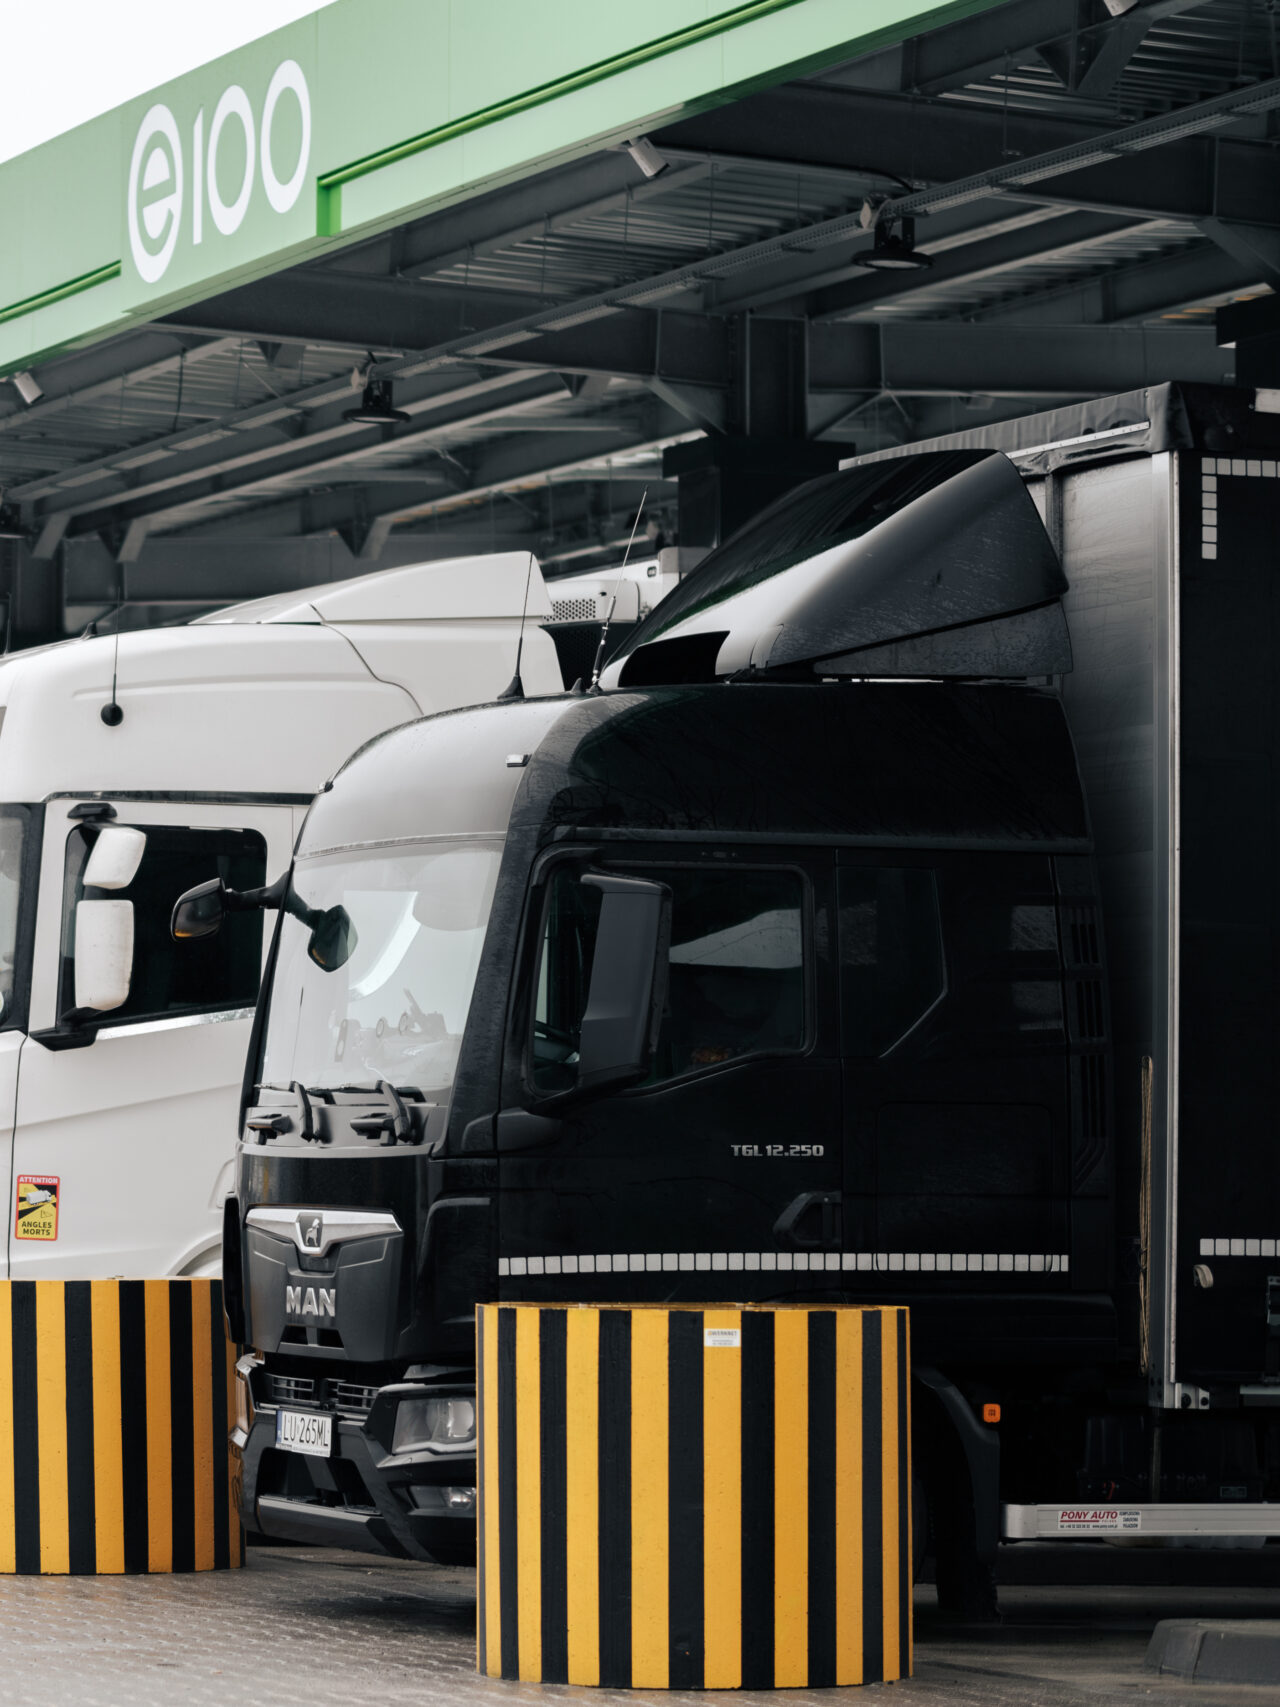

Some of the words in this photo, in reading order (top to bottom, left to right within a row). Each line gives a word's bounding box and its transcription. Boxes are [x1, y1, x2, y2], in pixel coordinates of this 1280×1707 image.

[128, 59, 312, 284] e100
[730, 1144, 763, 1157] TGL
[765, 1144, 825, 1157] 12.250
[19, 1176, 59, 1184] ATTENTION
[21, 1221, 53, 1229] ANGLES
[22, 1228, 51, 1236] MORTS
[286, 1285, 336, 1317] MAN
[283, 1414, 297, 1442] LU
[299, 1417, 329, 1447] 265ML
[1061, 1511, 1089, 1519] PONY
[1091, 1511, 1118, 1519] AUTO
